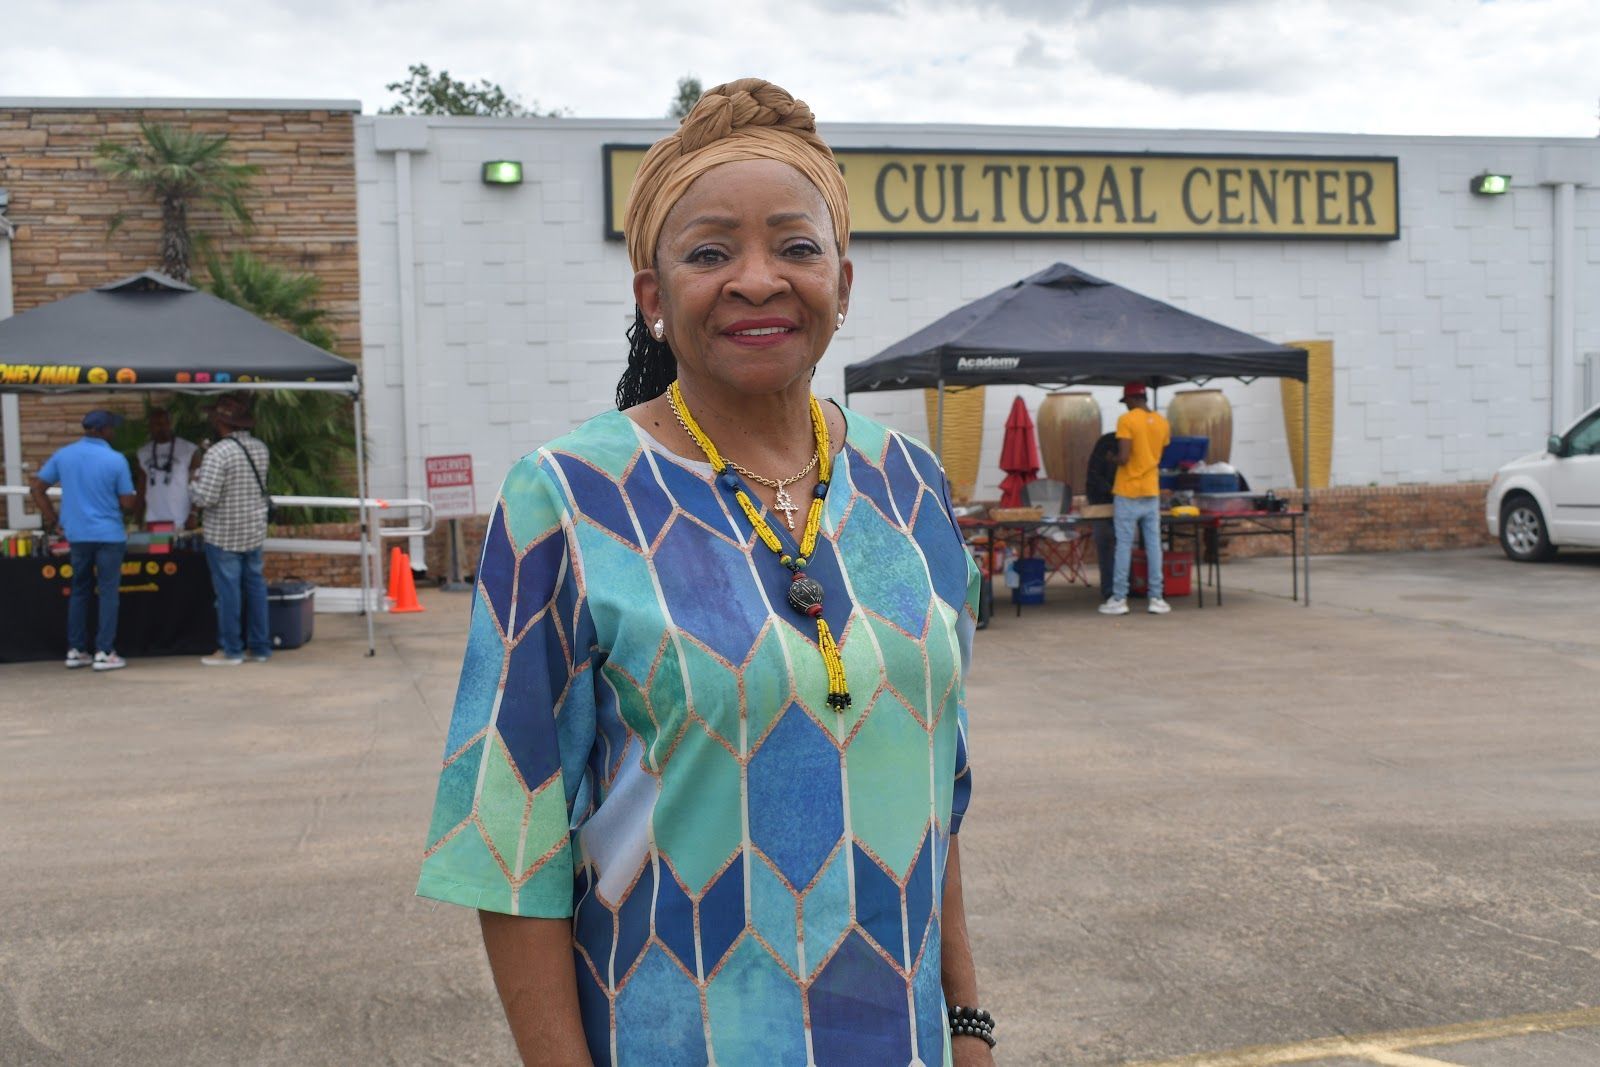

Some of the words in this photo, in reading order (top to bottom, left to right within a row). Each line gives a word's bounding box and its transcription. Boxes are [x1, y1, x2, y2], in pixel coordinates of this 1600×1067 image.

[874, 162, 1157, 224] CULTURAL
[1182, 166, 1377, 226] CENTER
[957, 356, 1020, 369] Academy
[428, 459, 469, 471] RESERVED
[432, 471, 468, 484] PARKING
